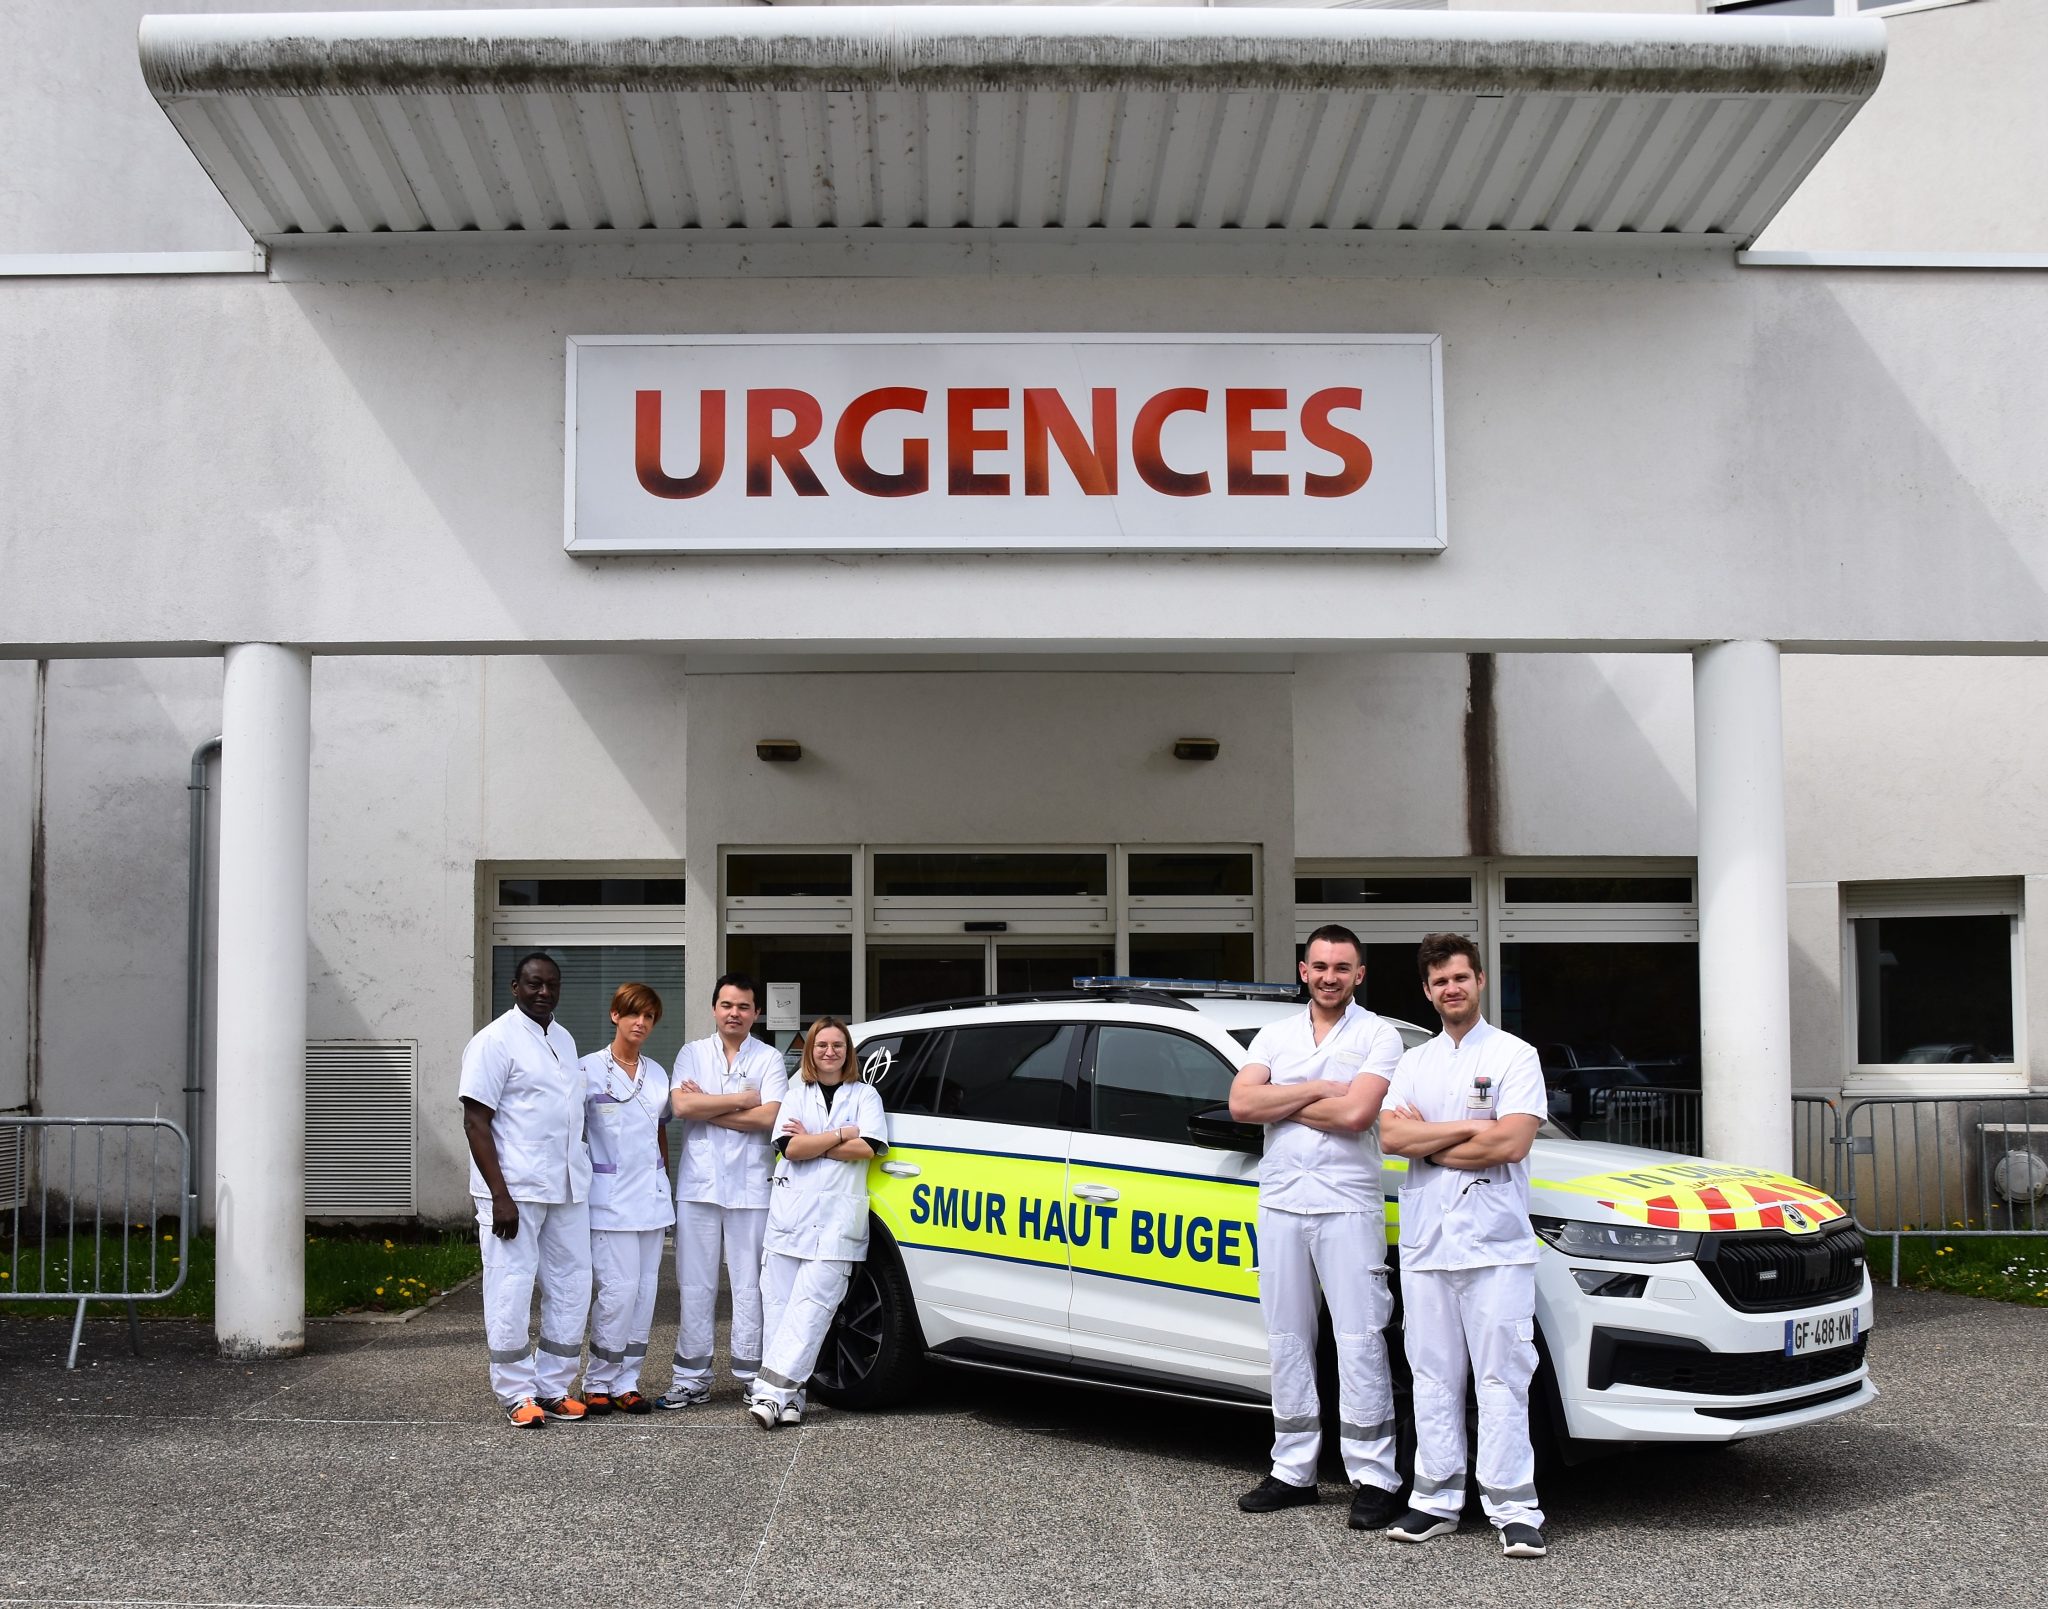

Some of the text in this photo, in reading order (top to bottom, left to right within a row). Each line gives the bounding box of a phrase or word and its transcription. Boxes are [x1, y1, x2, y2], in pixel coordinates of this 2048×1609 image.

[635, 387, 1373, 499] URGENCES
[910, 1183, 1259, 1269] SMUR HAUT BUGEY
[1795, 1314, 1851, 1349] GF-488-KN
